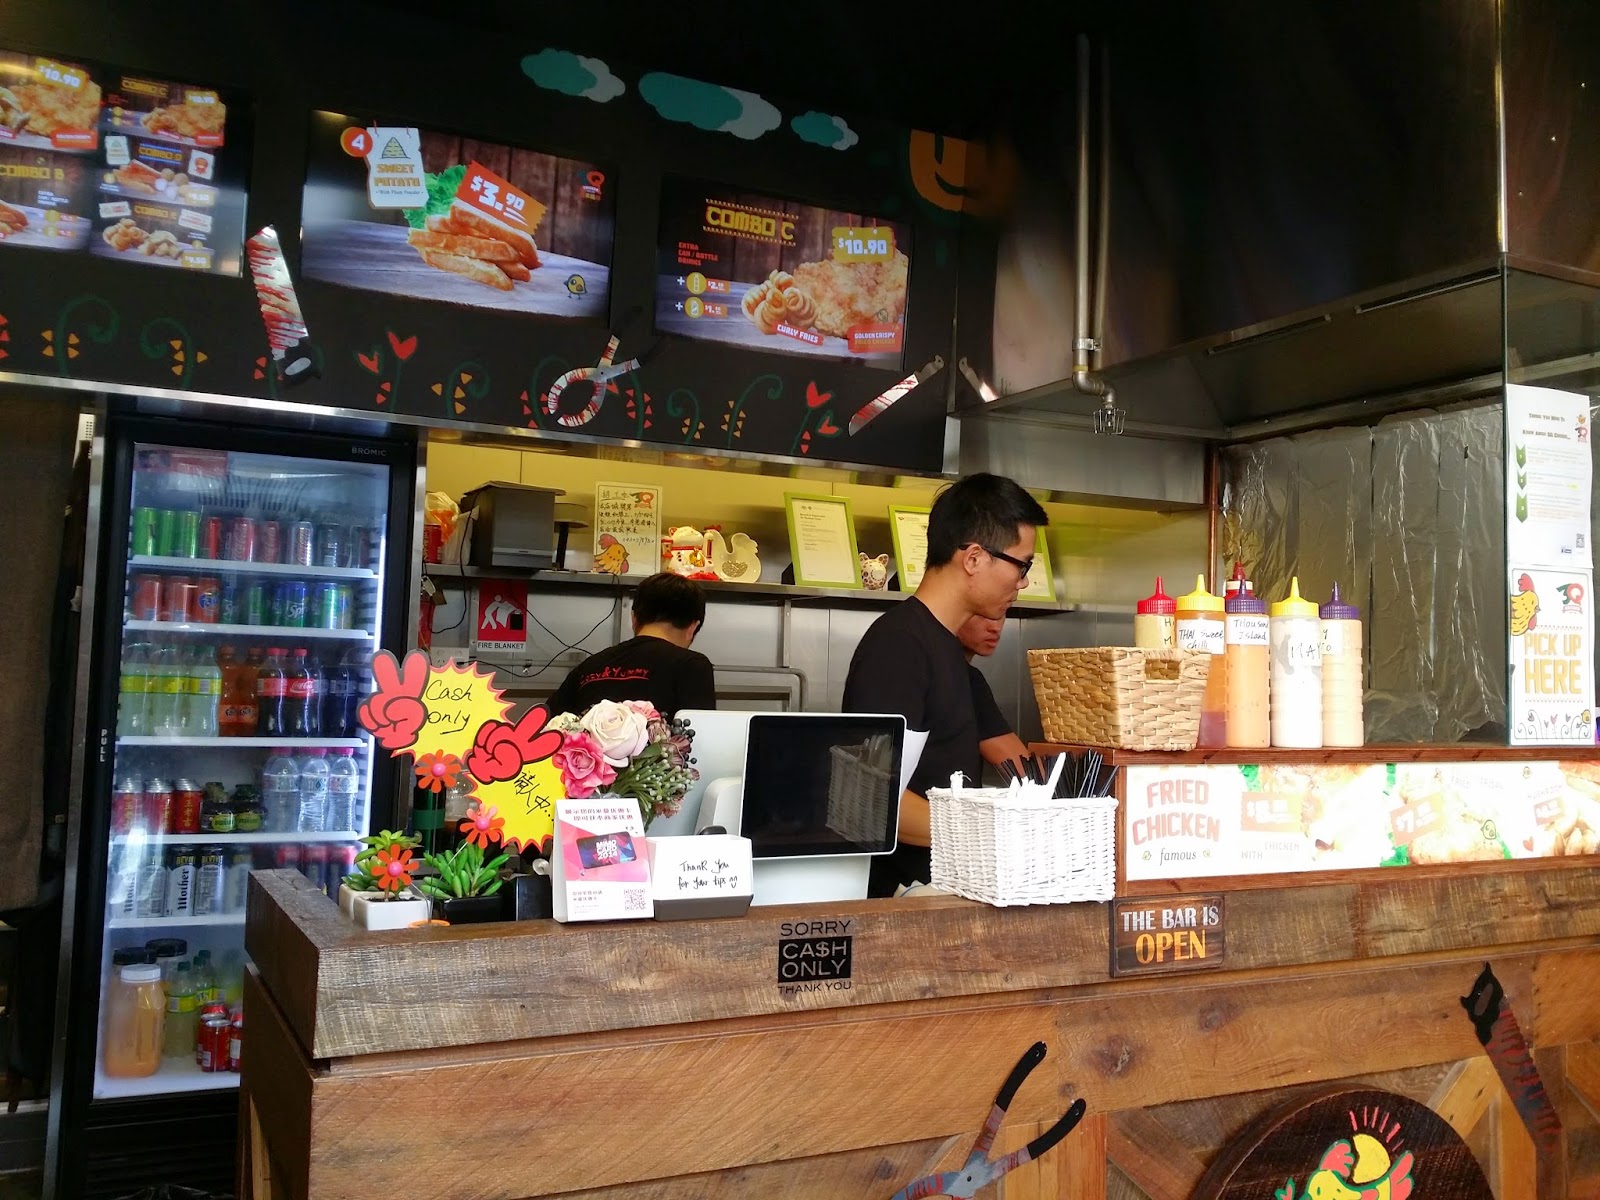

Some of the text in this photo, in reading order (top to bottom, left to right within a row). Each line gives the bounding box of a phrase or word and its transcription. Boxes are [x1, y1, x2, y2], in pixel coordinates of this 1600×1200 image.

[351, 134, 365, 151] 4
[377, 164, 414, 174] SWEET
[374, 177, 421, 187] POTATO
[470, 175, 525, 211] $3.90
[706, 206, 795, 240] COMBO C
[838, 238, 887, 255] $10.90
[777, 324, 819, 344] CURLY FRIES
[854, 332, 876, 340] GOLDEN
[351, 446, 387, 457] BROMIC
[477, 641, 525, 650] FIRE BLANKET
[1523, 632, 1582, 657] PICK UP
[1524, 658, 1582, 695] HERE
[426, 680, 473, 702] Cash
[1146, 779, 1210, 809] FRIED
[1132, 812, 1221, 846] CHICKEN
[1160, 848, 1197, 866] famous
[1121, 905, 1220, 932] THE BAR IS
[780, 920, 851, 937] SORRY
[782, 941, 847, 960] CA$H
[1135, 929, 1206, 965] OPEN
[781, 959, 847, 979] ONLY
[778, 981, 852, 995] THANK YOU
